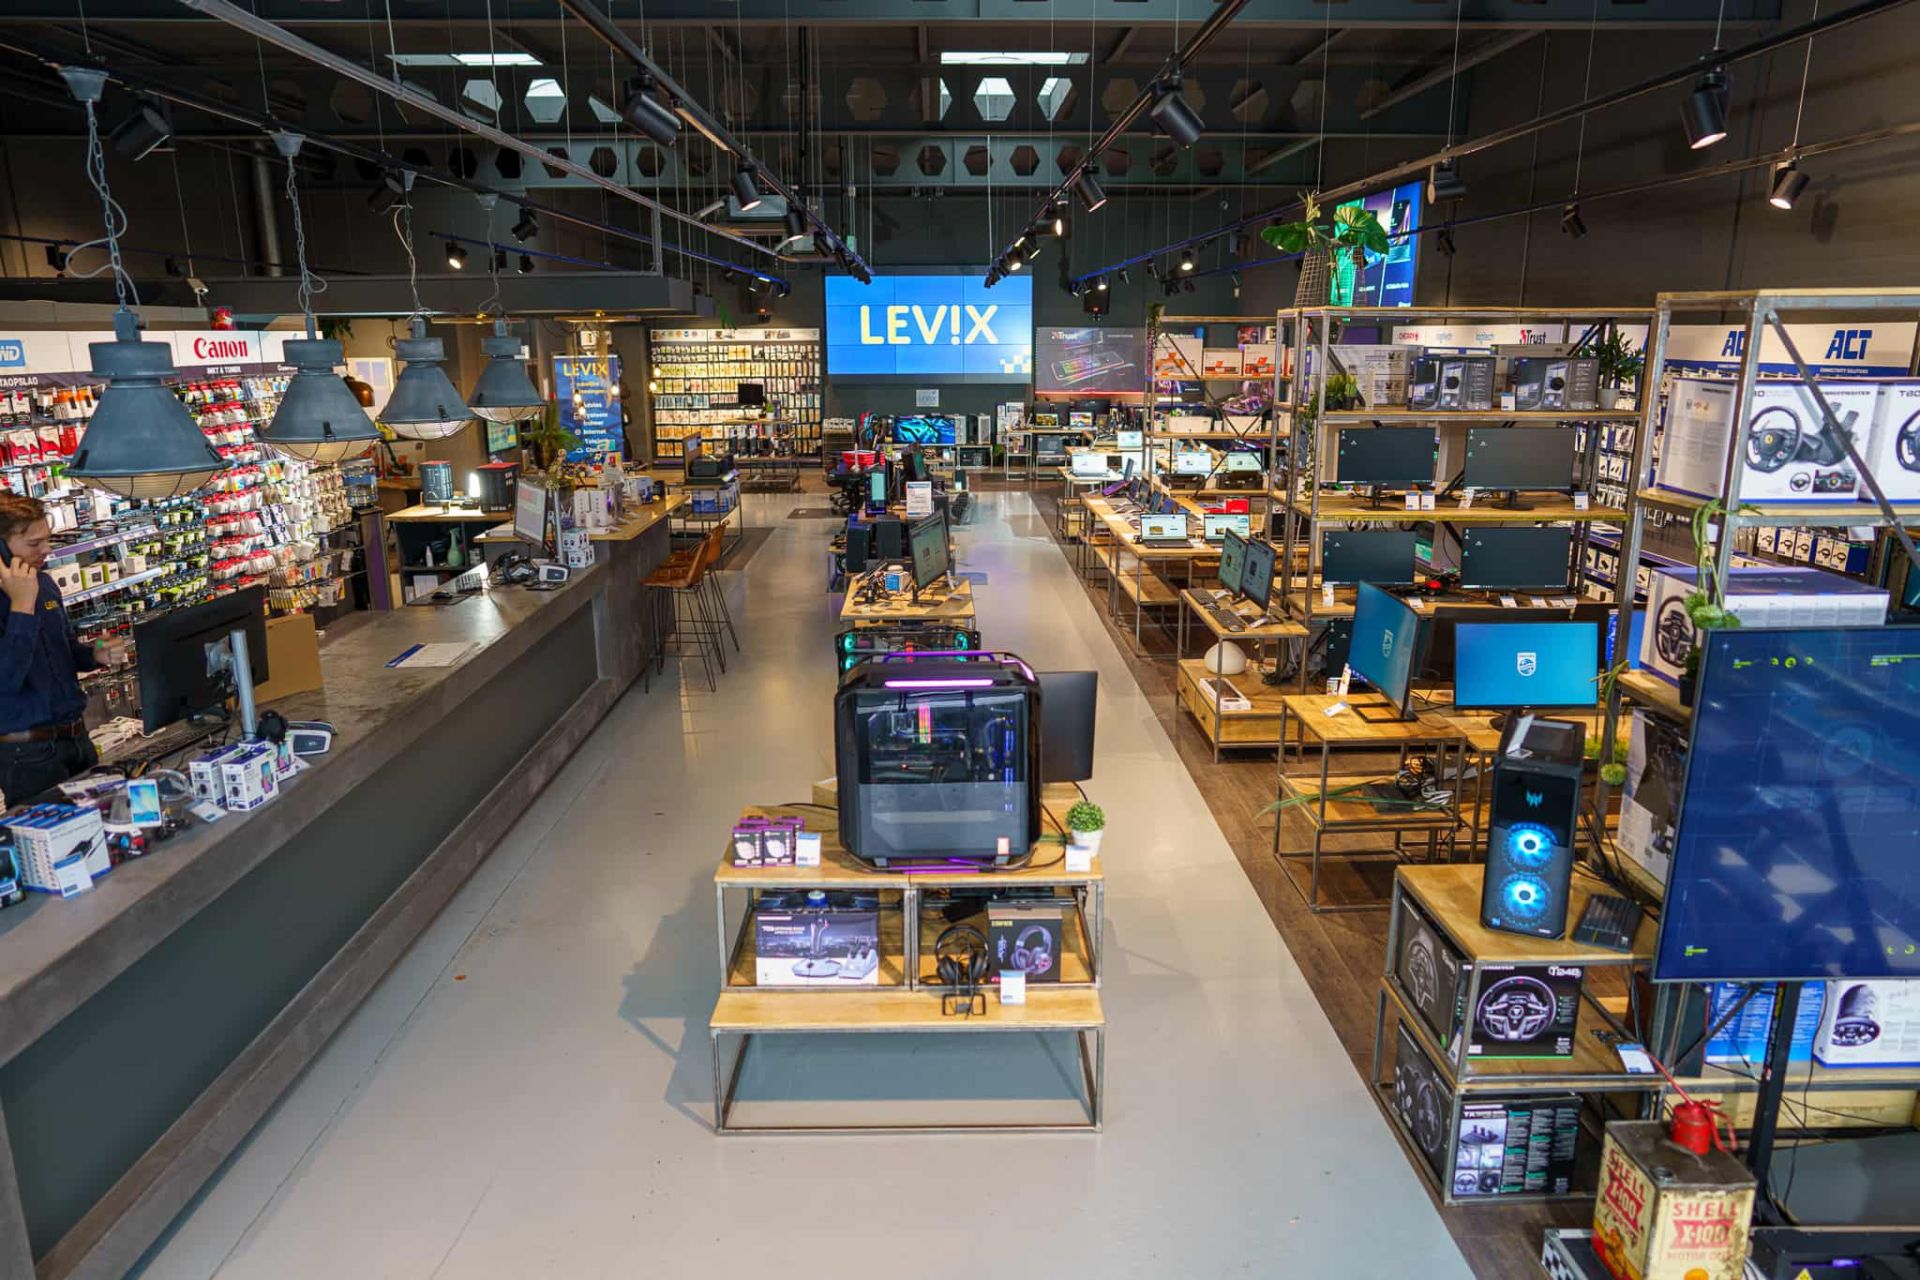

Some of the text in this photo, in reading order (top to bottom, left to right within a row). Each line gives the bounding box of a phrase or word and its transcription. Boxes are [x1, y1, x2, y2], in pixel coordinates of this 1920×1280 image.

[861, 305, 999, 345] LEV!X
[193, 337, 248, 359] Canon
[1527, 330, 1546, 345] Trust
[1825, 330, 1873, 360] ACT
[1673, 1201, 1738, 1217] SHELL
